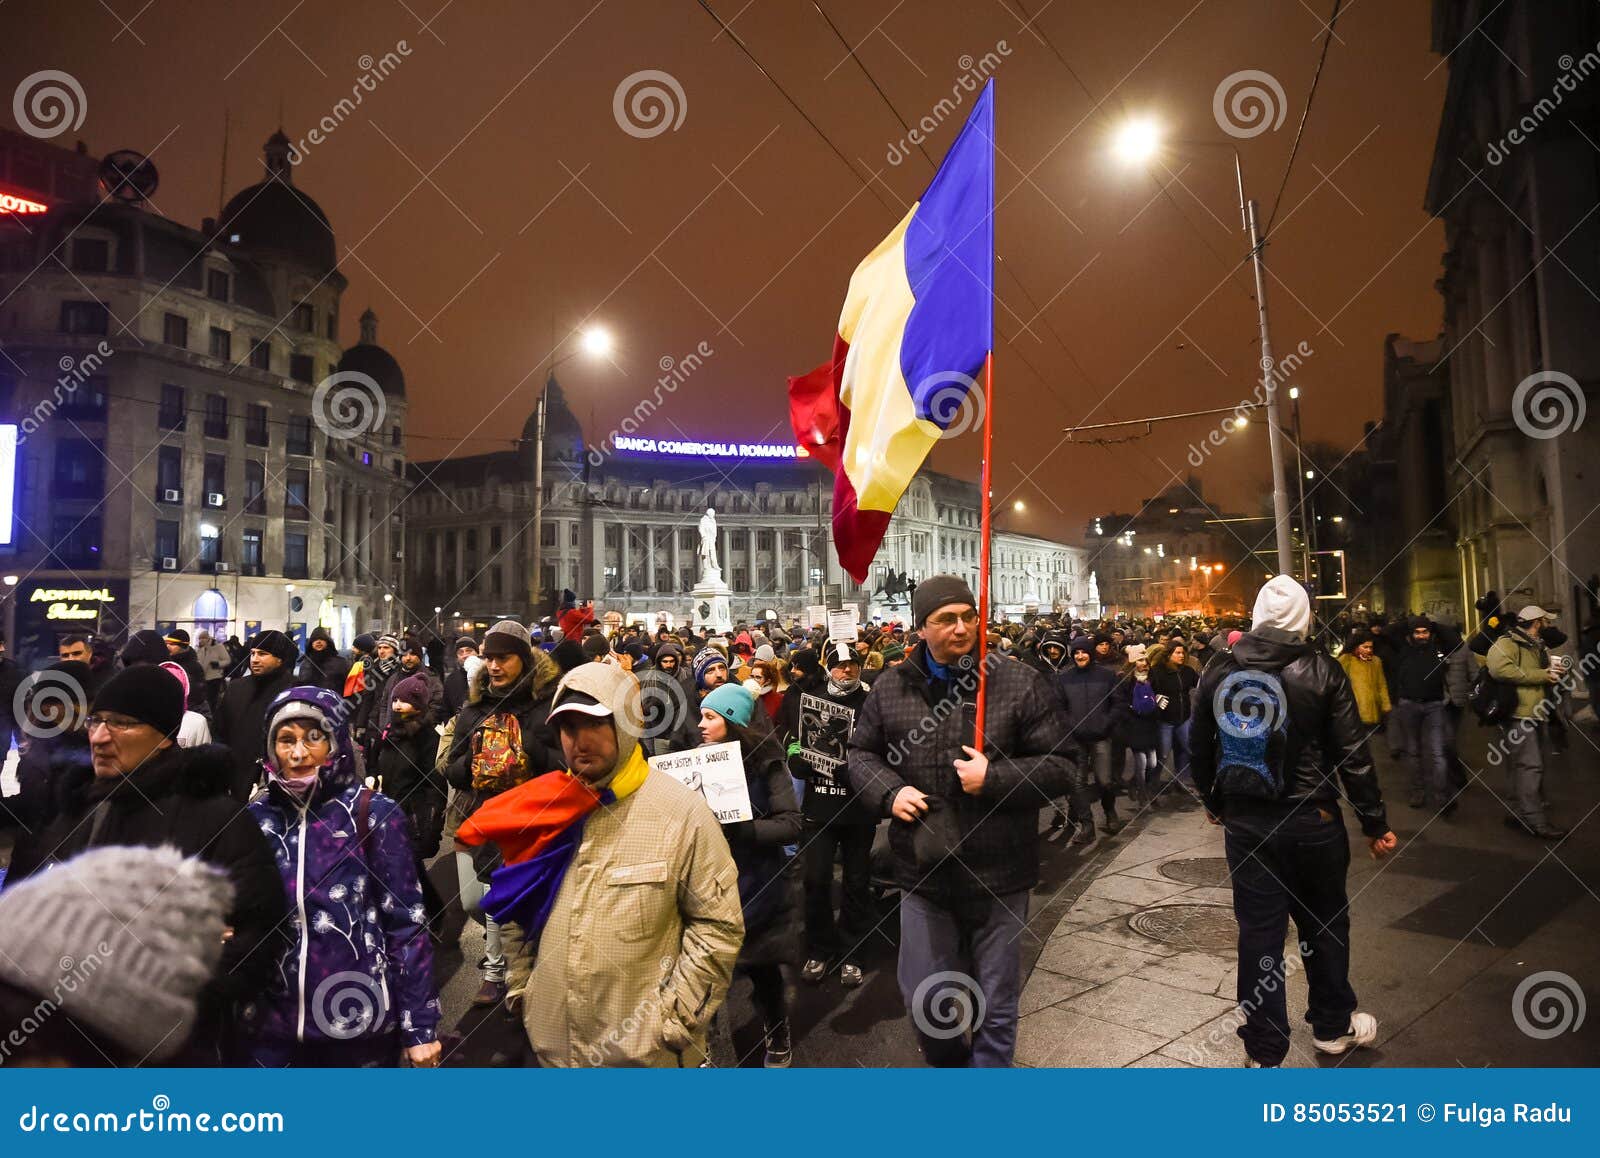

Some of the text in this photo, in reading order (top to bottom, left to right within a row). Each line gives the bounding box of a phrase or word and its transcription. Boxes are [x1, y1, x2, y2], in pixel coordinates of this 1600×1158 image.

[615, 436, 796, 458] BANCA COMERCIALA ROMANA
[30, 588, 115, 602] ADMIRAL
[815, 785, 847, 796] WE DIE
